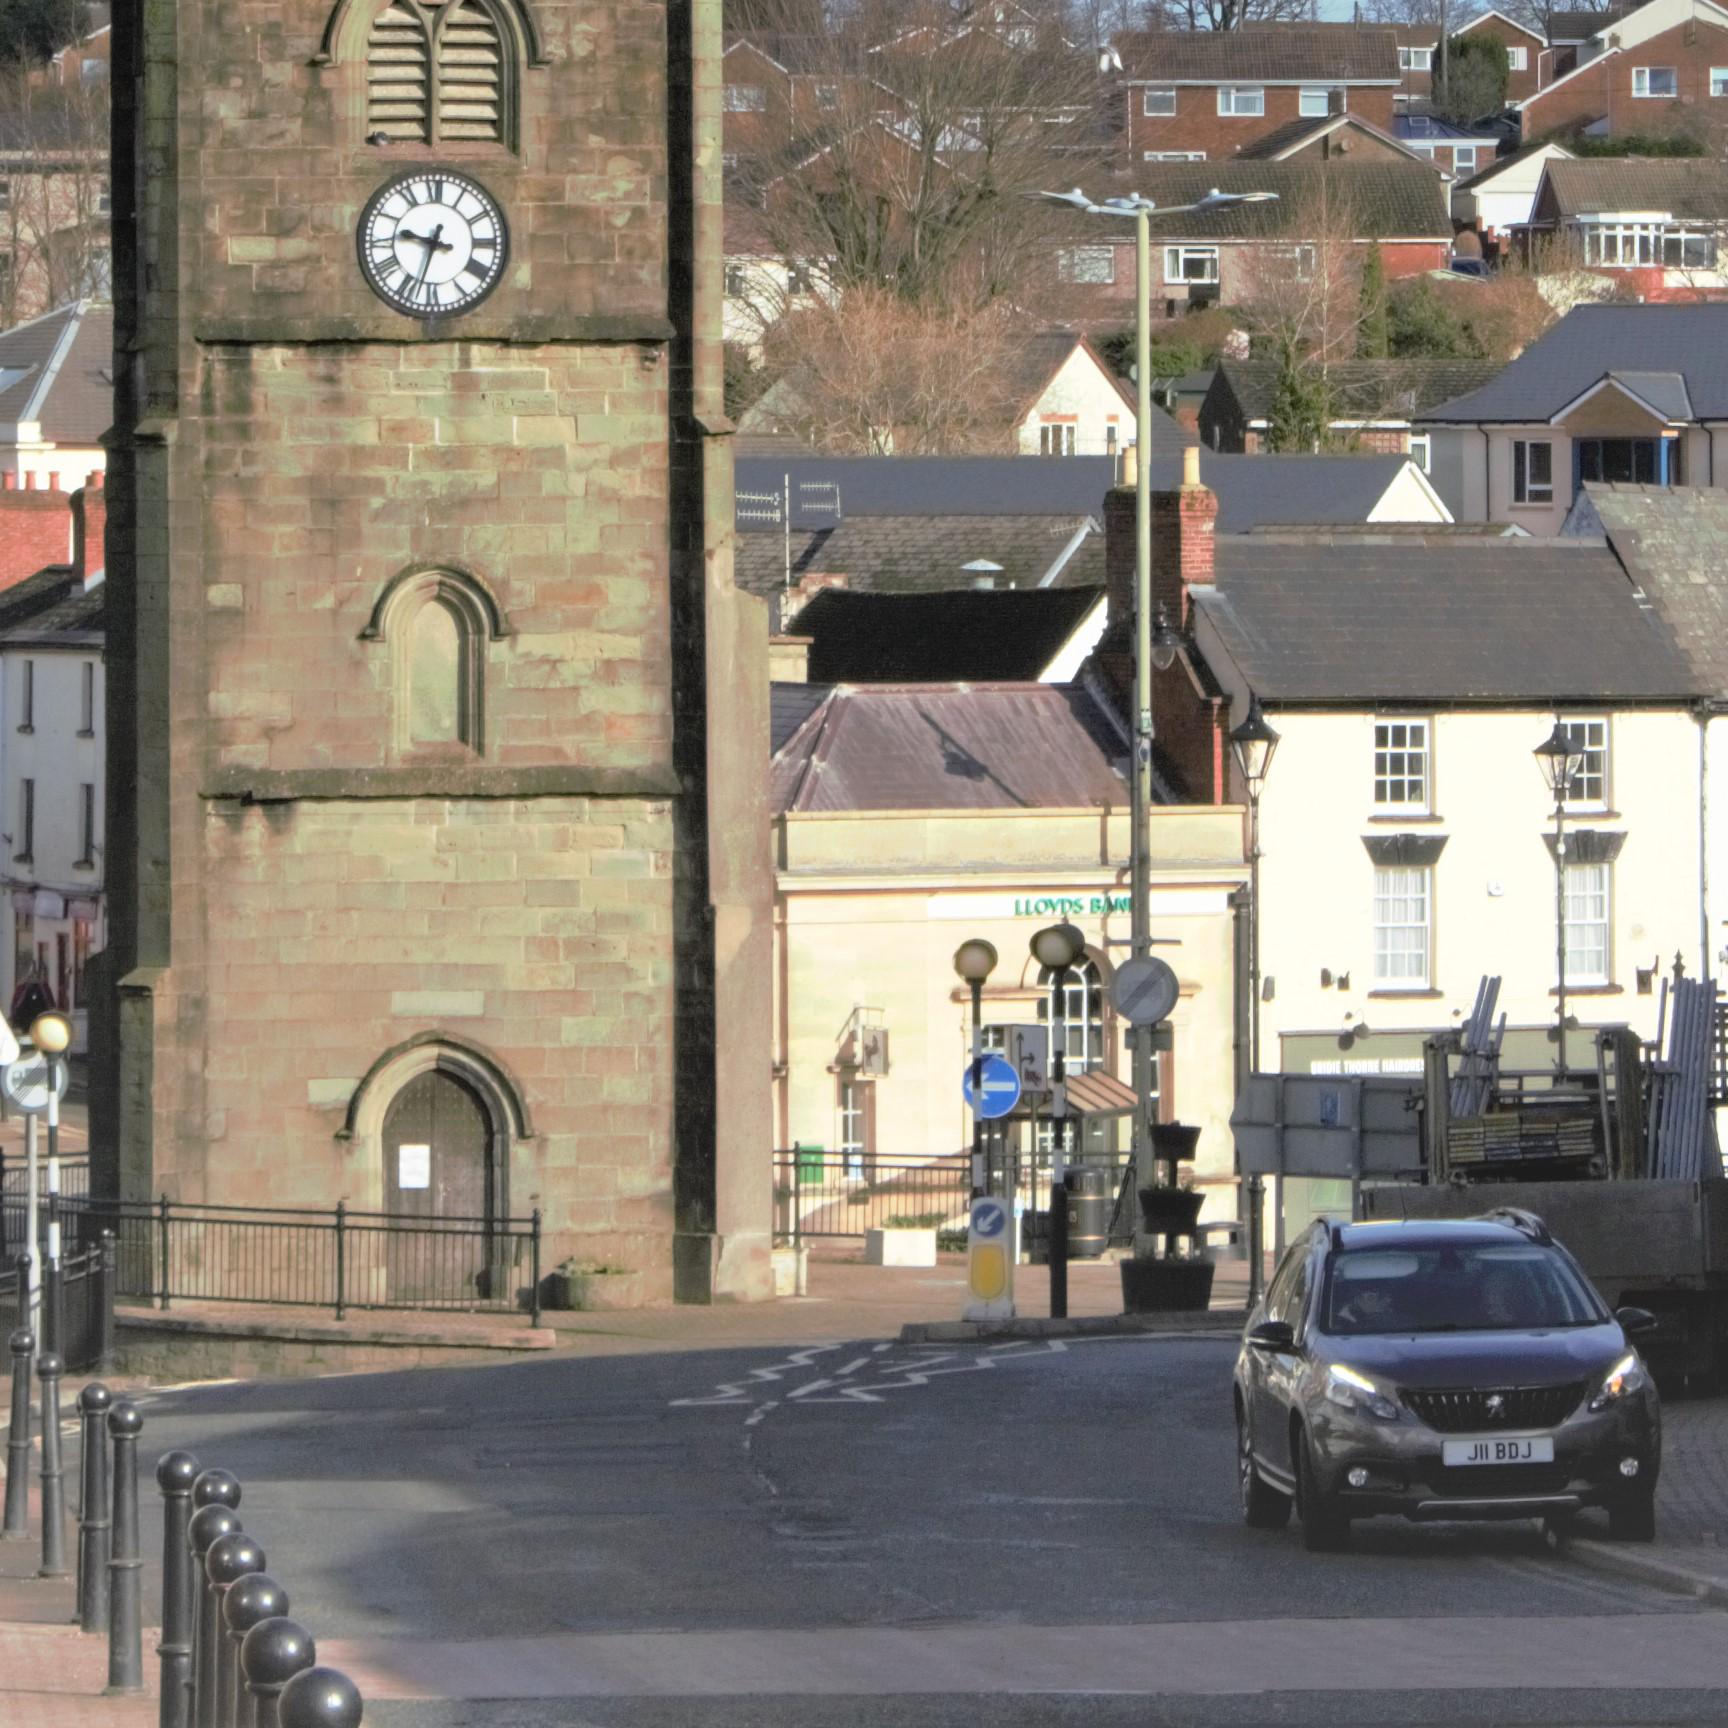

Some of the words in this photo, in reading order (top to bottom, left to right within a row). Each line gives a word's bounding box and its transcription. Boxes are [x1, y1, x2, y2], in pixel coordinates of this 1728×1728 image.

[1014, 897, 1085, 916] LLOYDS
[1090, 896, 1133, 914] BAN
[1495, 1441, 1532, 1460] BDJ
